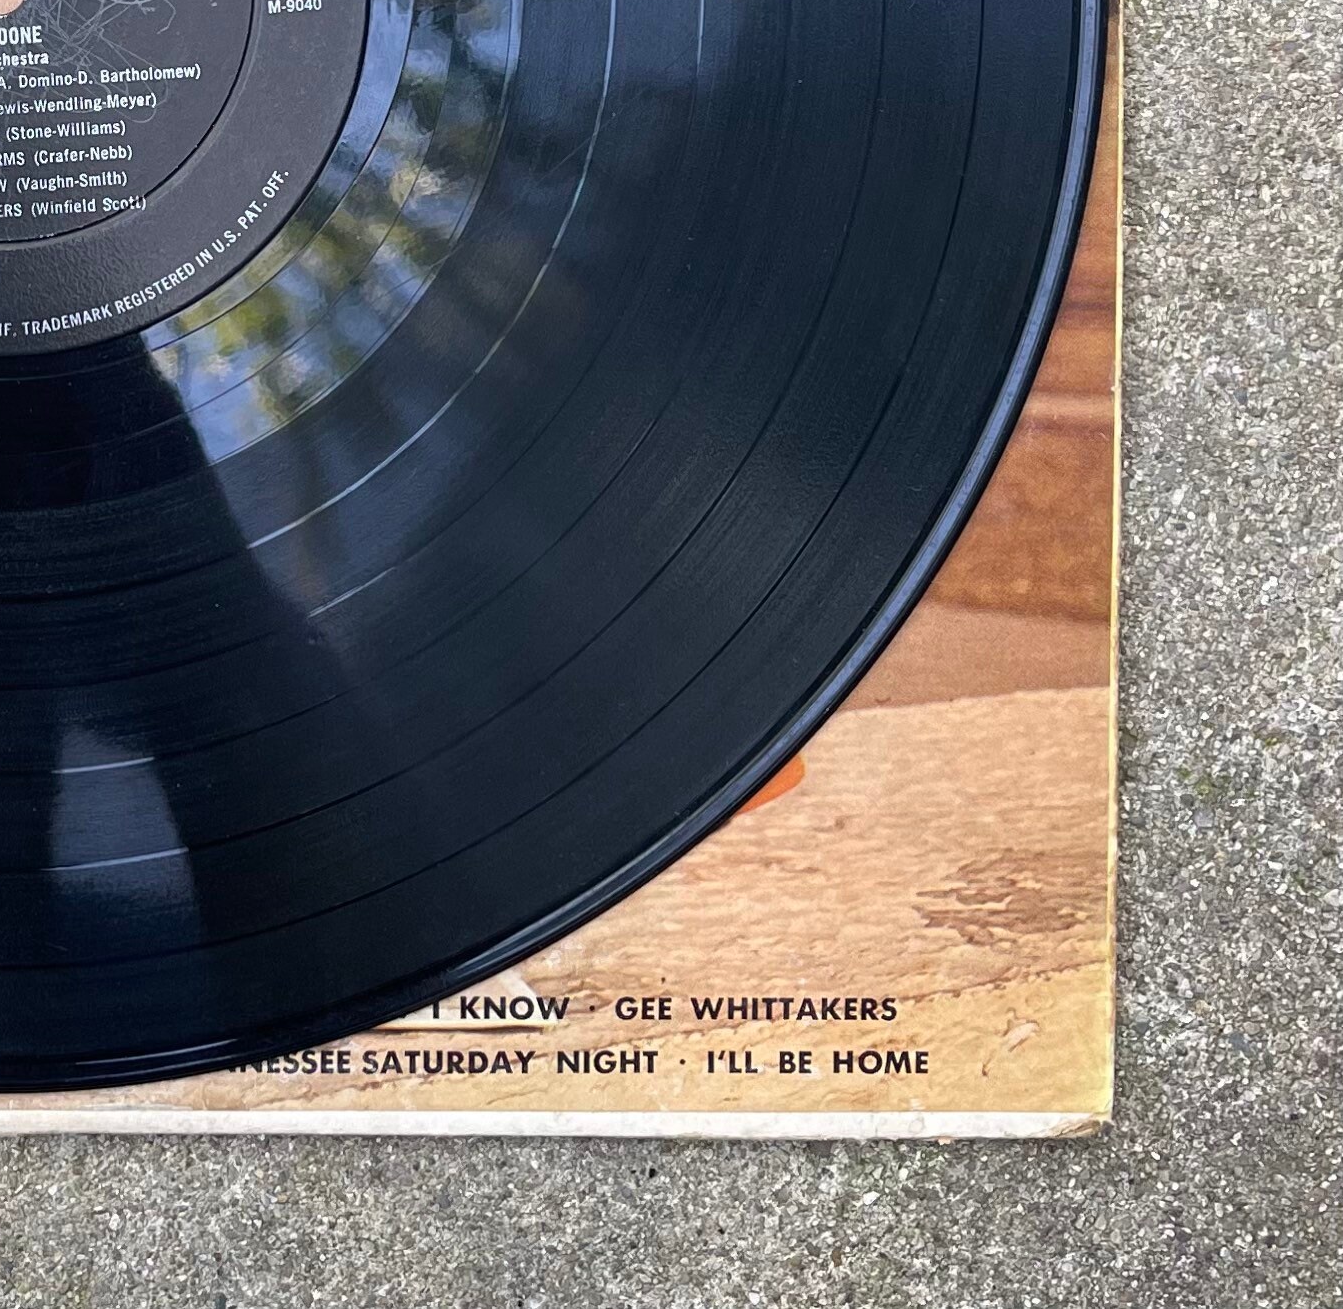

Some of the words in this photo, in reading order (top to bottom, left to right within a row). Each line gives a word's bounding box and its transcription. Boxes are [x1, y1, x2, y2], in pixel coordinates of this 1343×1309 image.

[18, 70, 93, 89] Domino-D.
[100, 63, 202, 84] Bartholomew)
[5, 120, 127, 142] (Stone-Williams)
[34, 144, 133, 167] (Crafer-Nebb)
[16, 171, 128, 193] (Vaughn-Smith)
[31, 198, 97, 217] (Winfield
[101, 195, 148, 212] Scott)
[21, 303, 113, 336] TRADEMARK
[114, 262, 197, 315] REGISTERED
[194, 248, 214, 269] IN
[211, 228, 242, 255] U.S.
[236, 200, 268, 230] PAT.
[261, 169, 290, 200] OFF.
[459, 995, 571, 1020] KNOW
[614, 996, 673, 1021] GEE
[690, 996, 898, 1021] WHITTAKERS
[361, 1049, 538, 1075] SATURDAY
[557, 1049, 659, 1075] NIGHT
[707, 1050, 759, 1074] I'LL
[779, 1050, 813, 1074] BE
[832, 1049, 930, 1075] HOME
